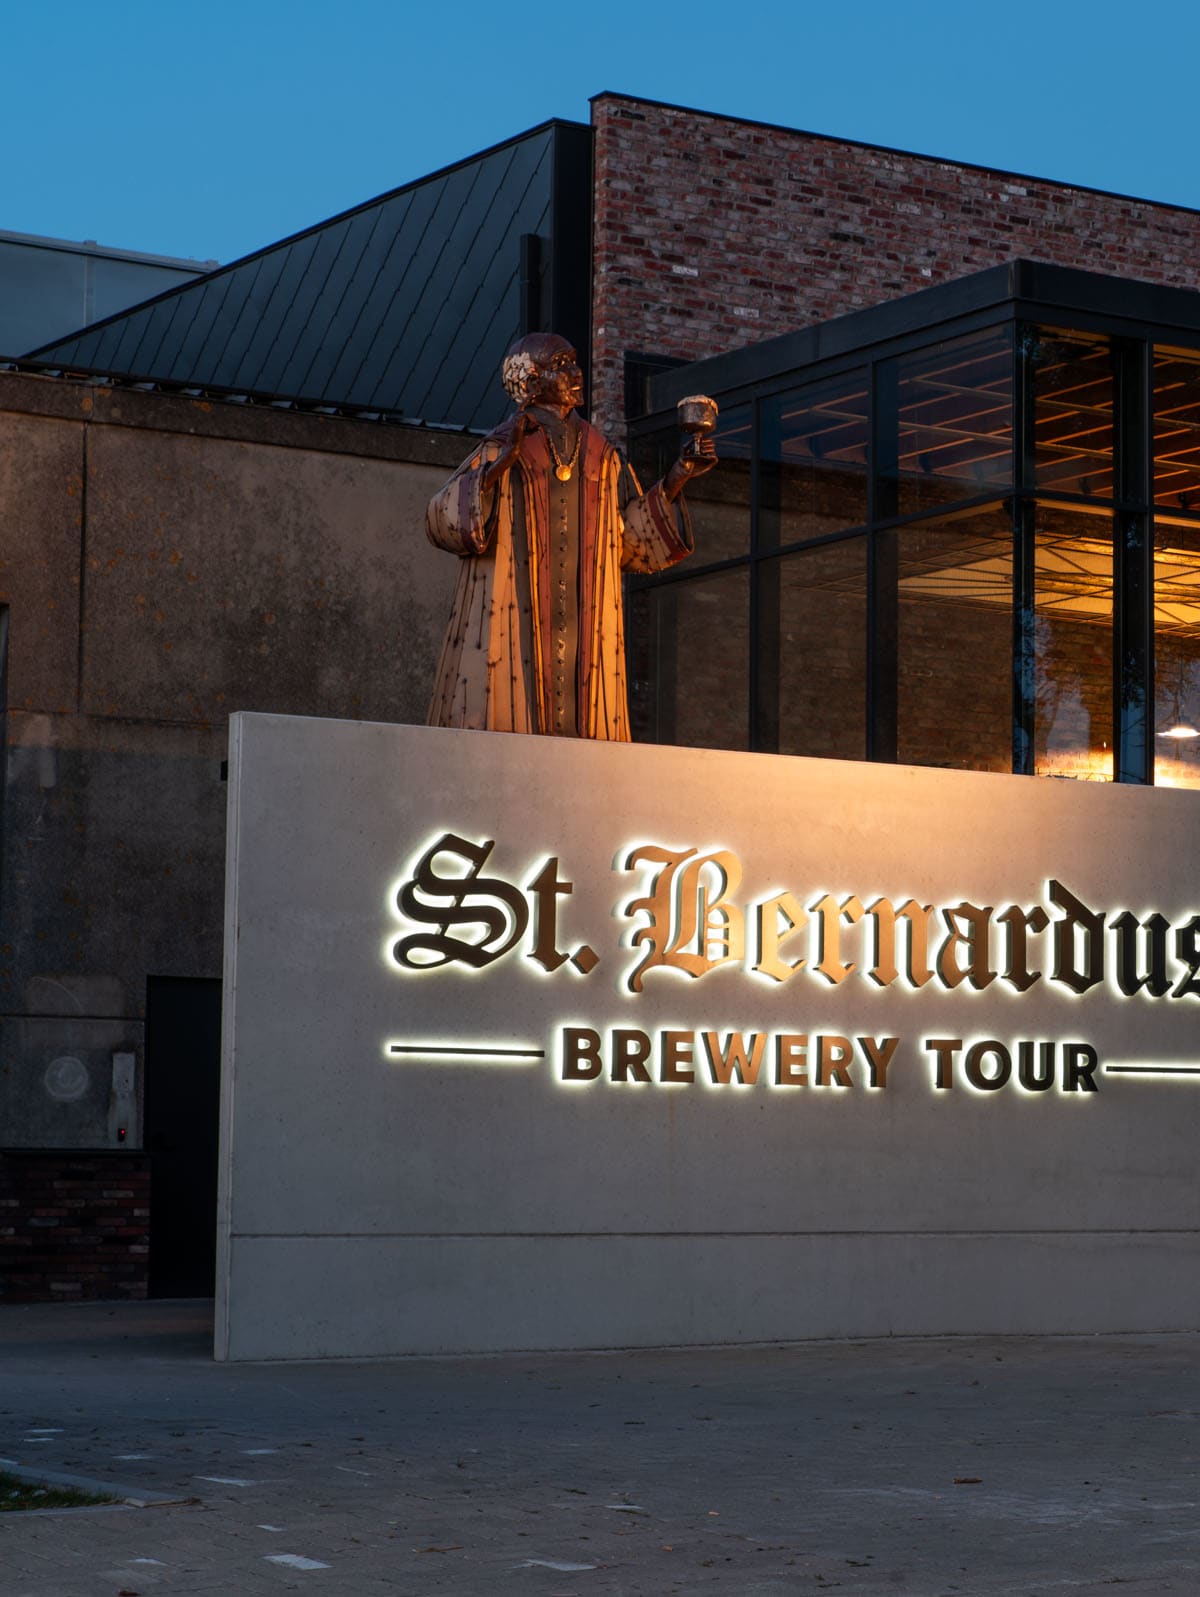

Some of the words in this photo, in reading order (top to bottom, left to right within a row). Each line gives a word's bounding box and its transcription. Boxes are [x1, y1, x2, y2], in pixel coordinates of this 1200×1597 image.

[395, 832, 599, 972] St.
[561, 1027, 900, 1089] BREWERY
[926, 1038, 1099, 1092] TOUR
